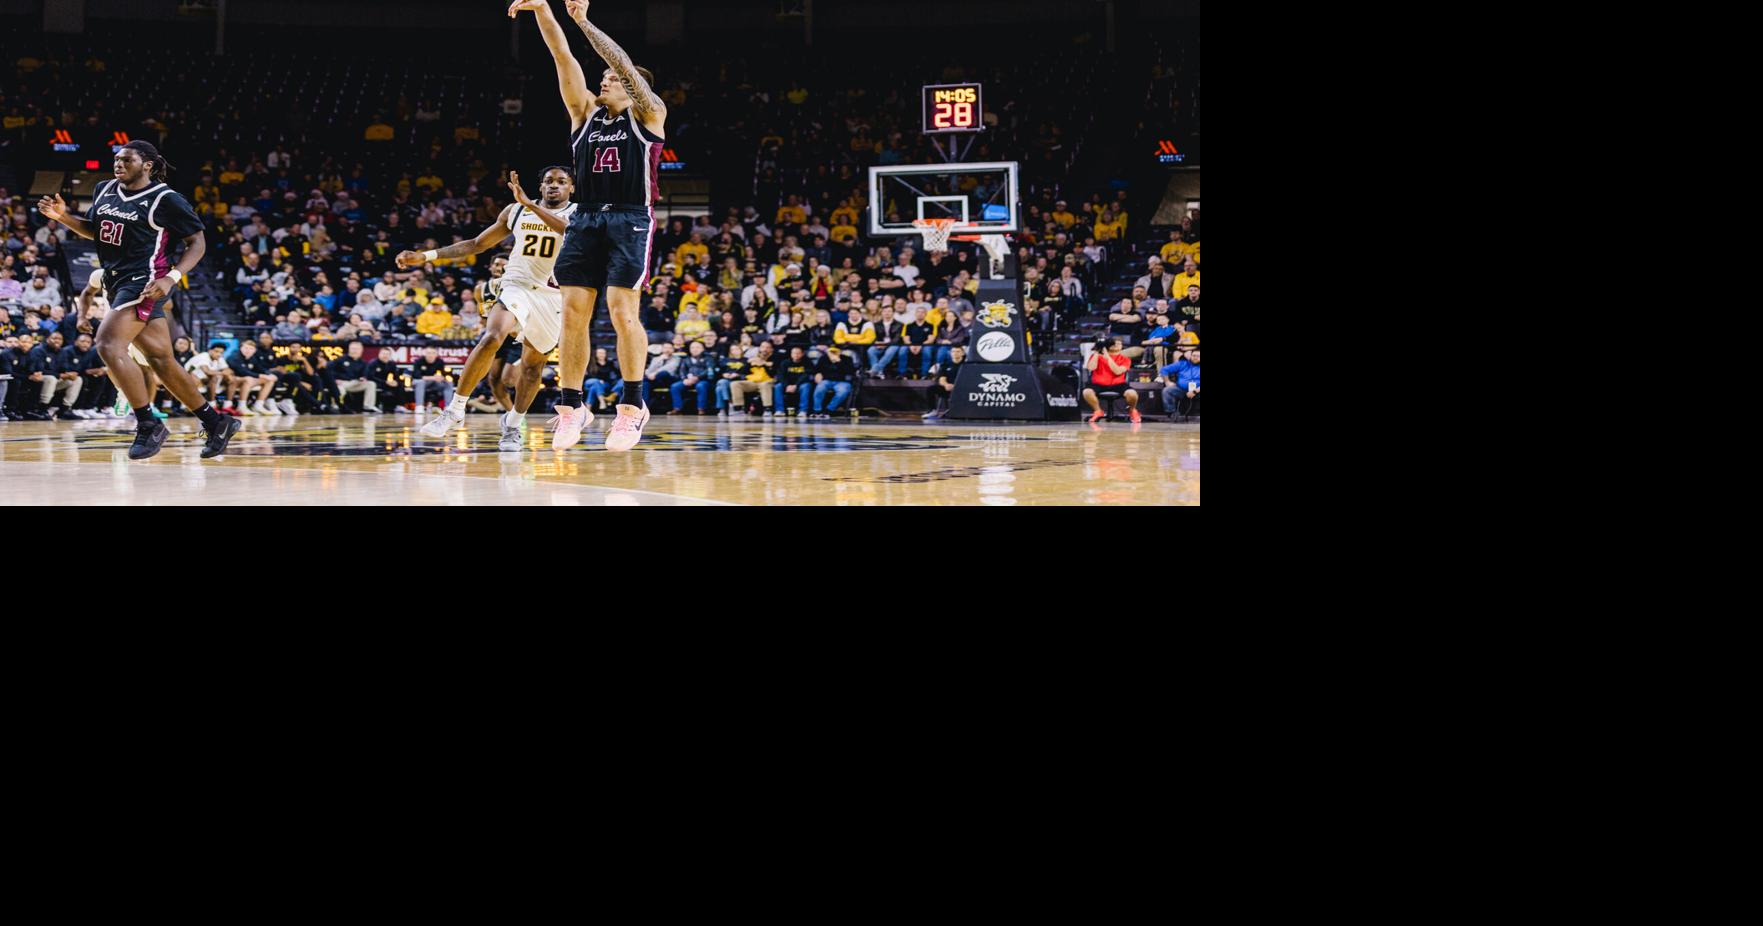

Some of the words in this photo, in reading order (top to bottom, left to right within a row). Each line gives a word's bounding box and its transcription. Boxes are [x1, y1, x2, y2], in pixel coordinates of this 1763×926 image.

[935, 88, 976, 103] 14:05
[934, 103, 972, 128] 28
[592, 147, 621, 172] 14
[100, 219, 125, 246] 21
[522, 233, 556, 258] 20
[968, 392, 1026, 402] DYNAMO
